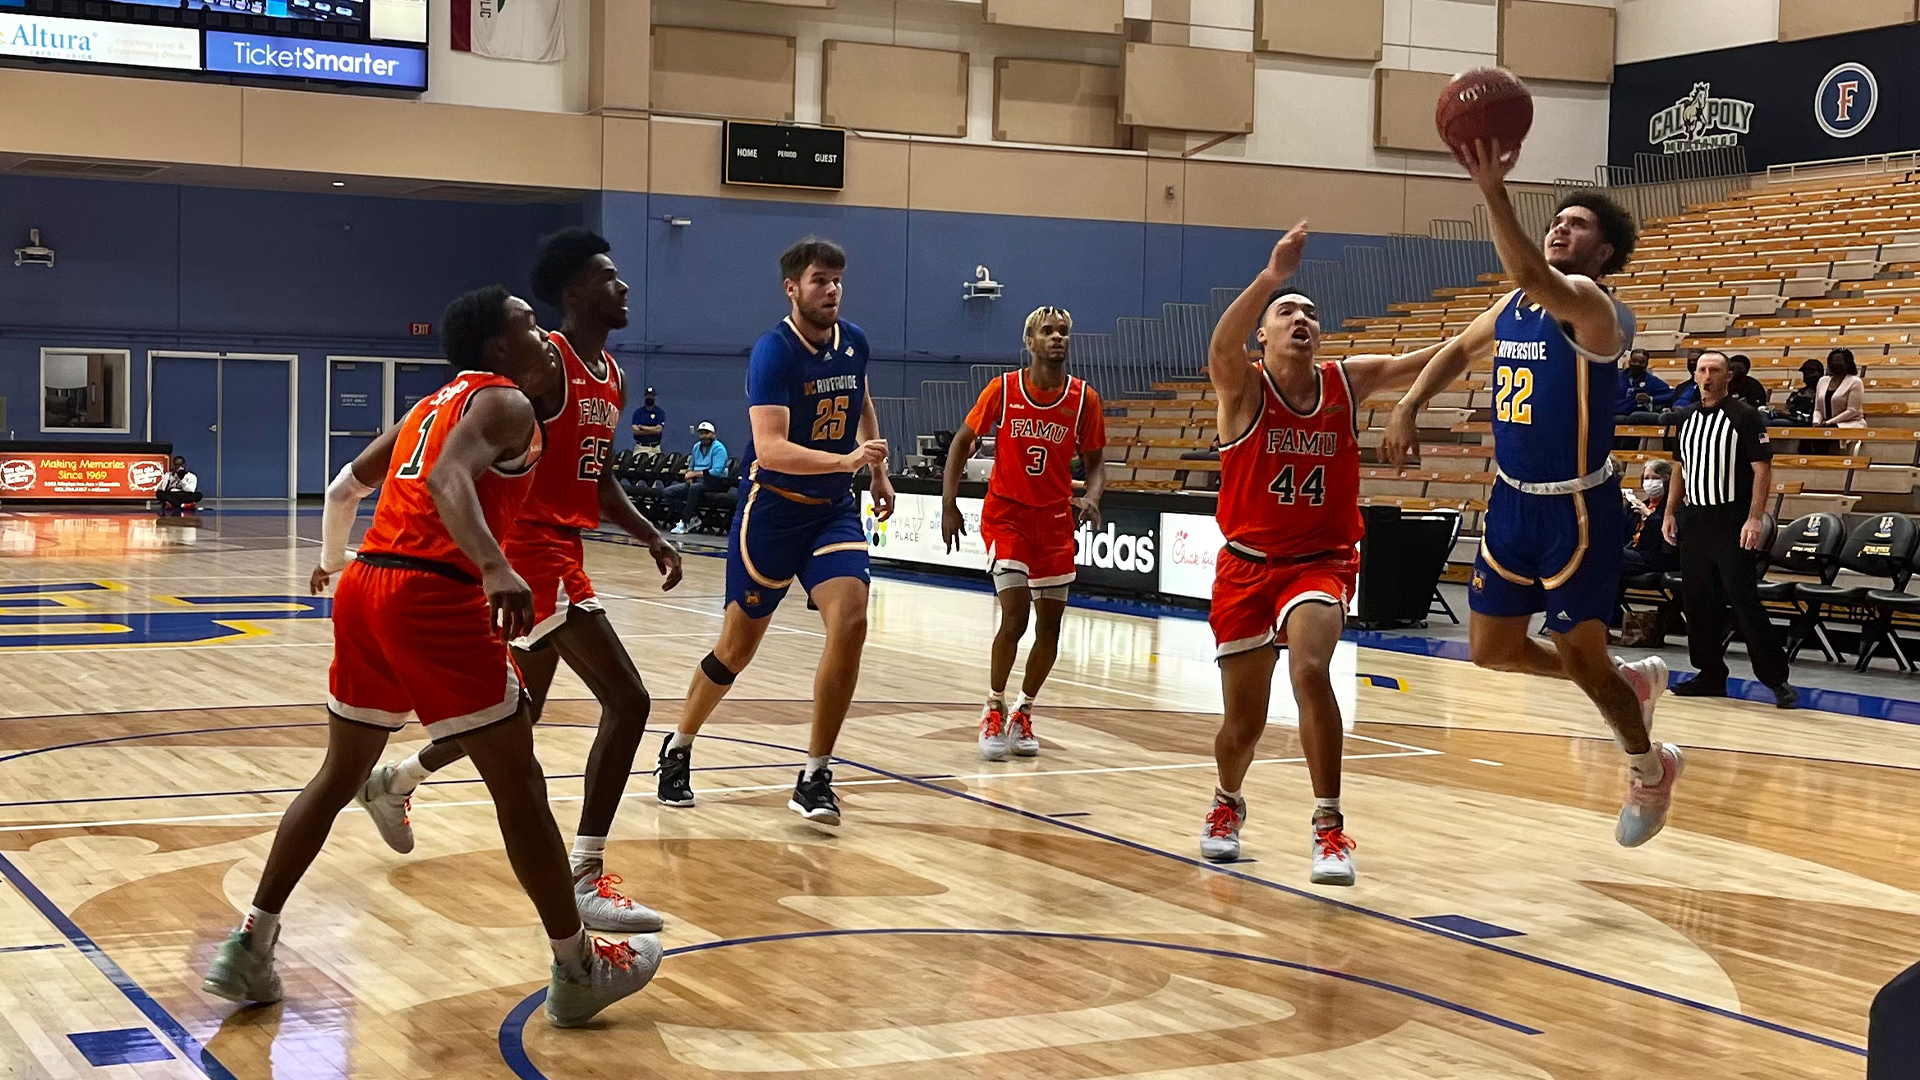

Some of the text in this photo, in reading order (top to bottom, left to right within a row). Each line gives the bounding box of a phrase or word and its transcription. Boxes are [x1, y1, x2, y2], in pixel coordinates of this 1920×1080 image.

[480, 0, 491, 18] LIC
[11, 23, 91, 51] Altura
[233, 42, 397, 76] TicketSmarter
[1835, 80, 1859, 122] F
[1650, 100, 1753, 143] CAL POLY
[737, 148, 837, 163] HOME PERIOD GUEST
[412, 324, 429, 335] EXIT
[1499, 340, 1547, 360] RIVERSIDE
[816, 375, 857, 393] RIVERSIDE
[1496, 366, 1533, 425] 22
[811, 396, 849, 440] 25
[1010, 418, 1069, 444] FAMU
[395, 409, 439, 479] 1
[1266, 427, 1338, 457] FAMU
[40, 459, 125, 471] Making Memories
[1025, 445, 1048, 476] 3
[58, 471, 107, 480] Since 1969
[1268, 464, 1326, 506] 44
[890, 517, 925, 530] HYATT
[970, 513, 980, 523] TO
[894, 531, 919, 542] PLACE
[1074, 520, 1154, 573] didas
[1172, 538, 1216, 569] Chick-fil
